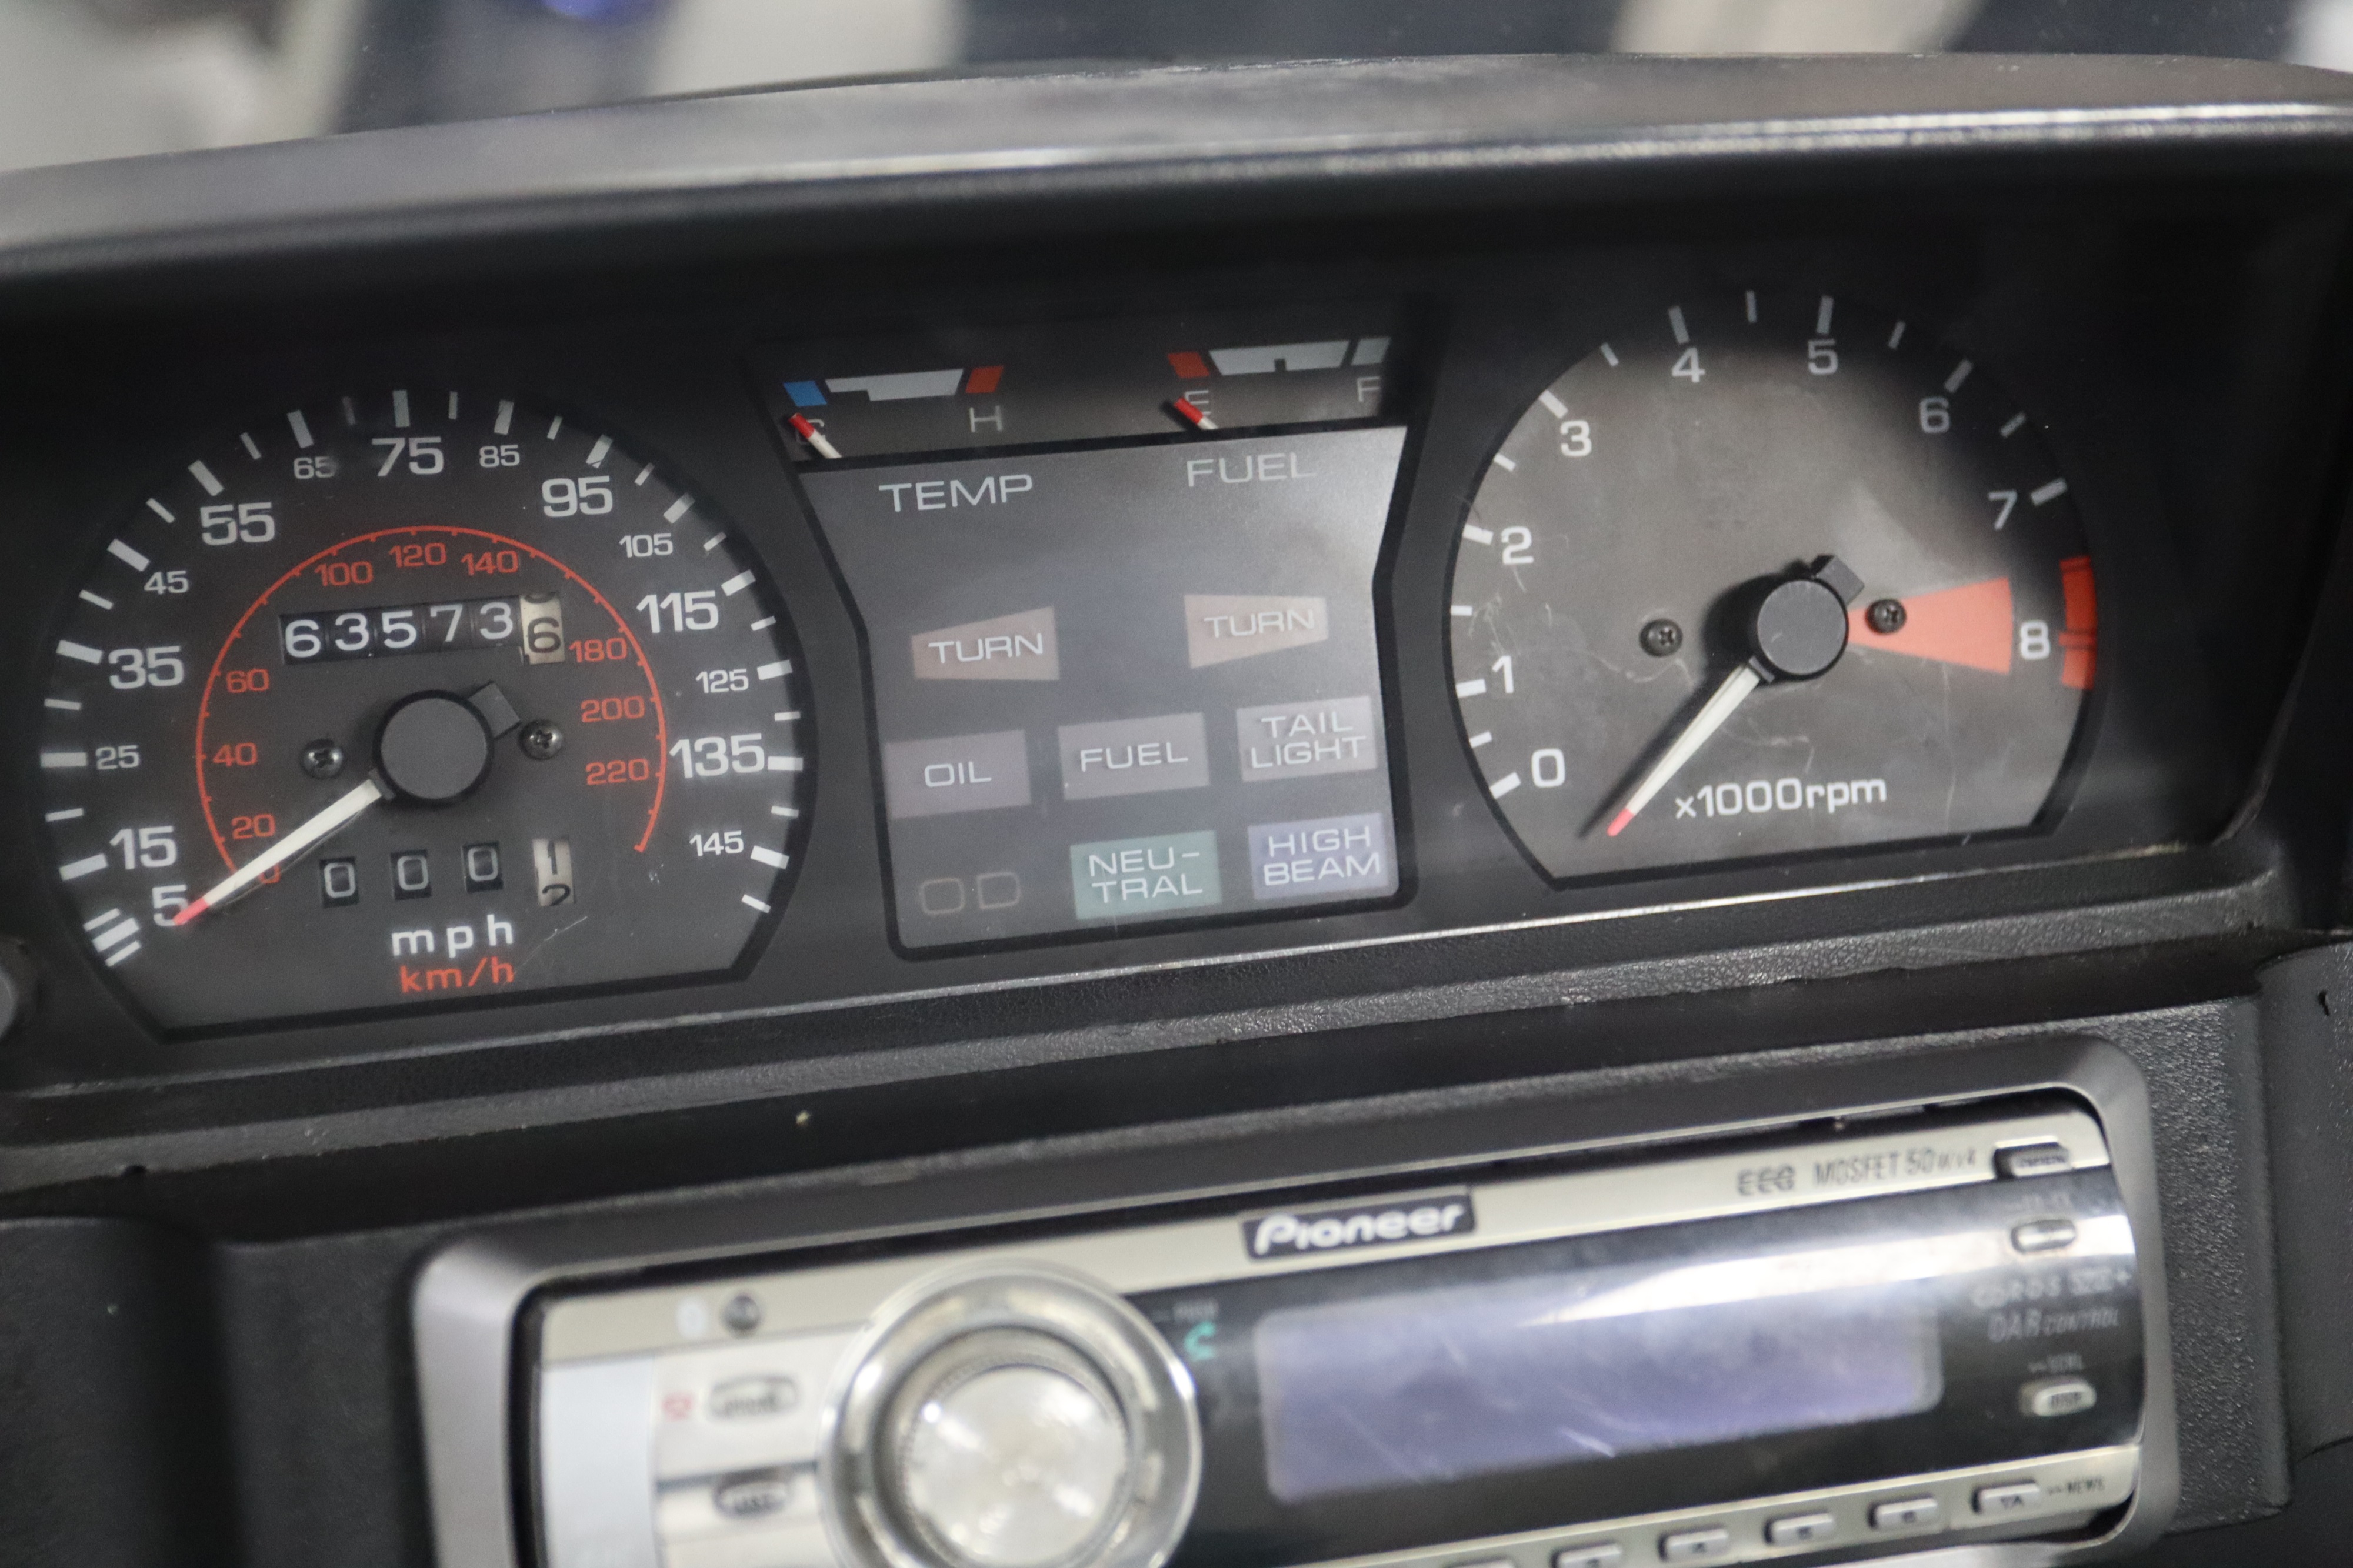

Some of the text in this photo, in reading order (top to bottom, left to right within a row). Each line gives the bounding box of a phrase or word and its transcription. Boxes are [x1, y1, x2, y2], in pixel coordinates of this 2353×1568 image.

[1671, 347, 1705, 383] 4
[1807, 339, 1838, 376] 5
[1357, 376, 1381, 402] F
[969, 405, 1003, 433] H
[1919, 396, 1949, 433] 6
[1560, 419, 1592, 458] 3
[294, 456, 336, 479] 65
[371, 436, 444, 477] 75
[479, 444, 520, 468] 85
[1187, 452, 1317, 487] FUEL
[542, 475, 613, 518] 95
[879, 473, 1033, 512] TEMP
[200, 502, 276, 546] 55
[1988, 490, 2017, 530] 7
[388, 542, 447, 568] 120
[619, 532, 673, 558] 105
[1500, 526, 1534, 565] 2
[314, 560, 373, 587] 100
[461, 550, 519, 576] 140
[144, 570, 189, 595] 45
[636, 590, 719, 634] 115
[1204, 609, 1315, 639] TURN
[568, 636, 628, 663] 180
[928, 632, 1044, 665] TURN
[2019, 619, 2051, 661] 8
[108, 646, 185, 689] 35
[226, 668, 269, 693] 60
[695, 668, 749, 694] 125
[1491, 655, 1515, 695] 1
[580, 695, 645, 723] 200
[1261, 710, 1354, 739] TAIL
[95, 745, 140, 770] 25
[212, 742, 258, 766] 40
[669, 733, 765, 779] 135
[1080, 742, 1189, 772] FUEL
[1250, 735, 1367, 769] LIGHT
[1531, 748, 1565, 788] 0
[585, 758, 649, 785] 220
[924, 760, 992, 789] OIL
[231, 814, 276, 839] 20
[1268, 826, 1372, 858] HIGH
[109, 825, 177, 870] 15
[689, 830, 744, 857] 145
[1089, 845, 1201, 878] NEU-
[1264, 852, 1381, 886] BEAM
[152, 883, 188, 927] 5
[1091, 875, 1204, 905] TRAL
[392, 913, 514, 958] mph
[400, 955, 515, 993] km/h
[1813, 1150, 1899, 1187] MOSFET
[1254, 1202, 1465, 1256] Pioneer
